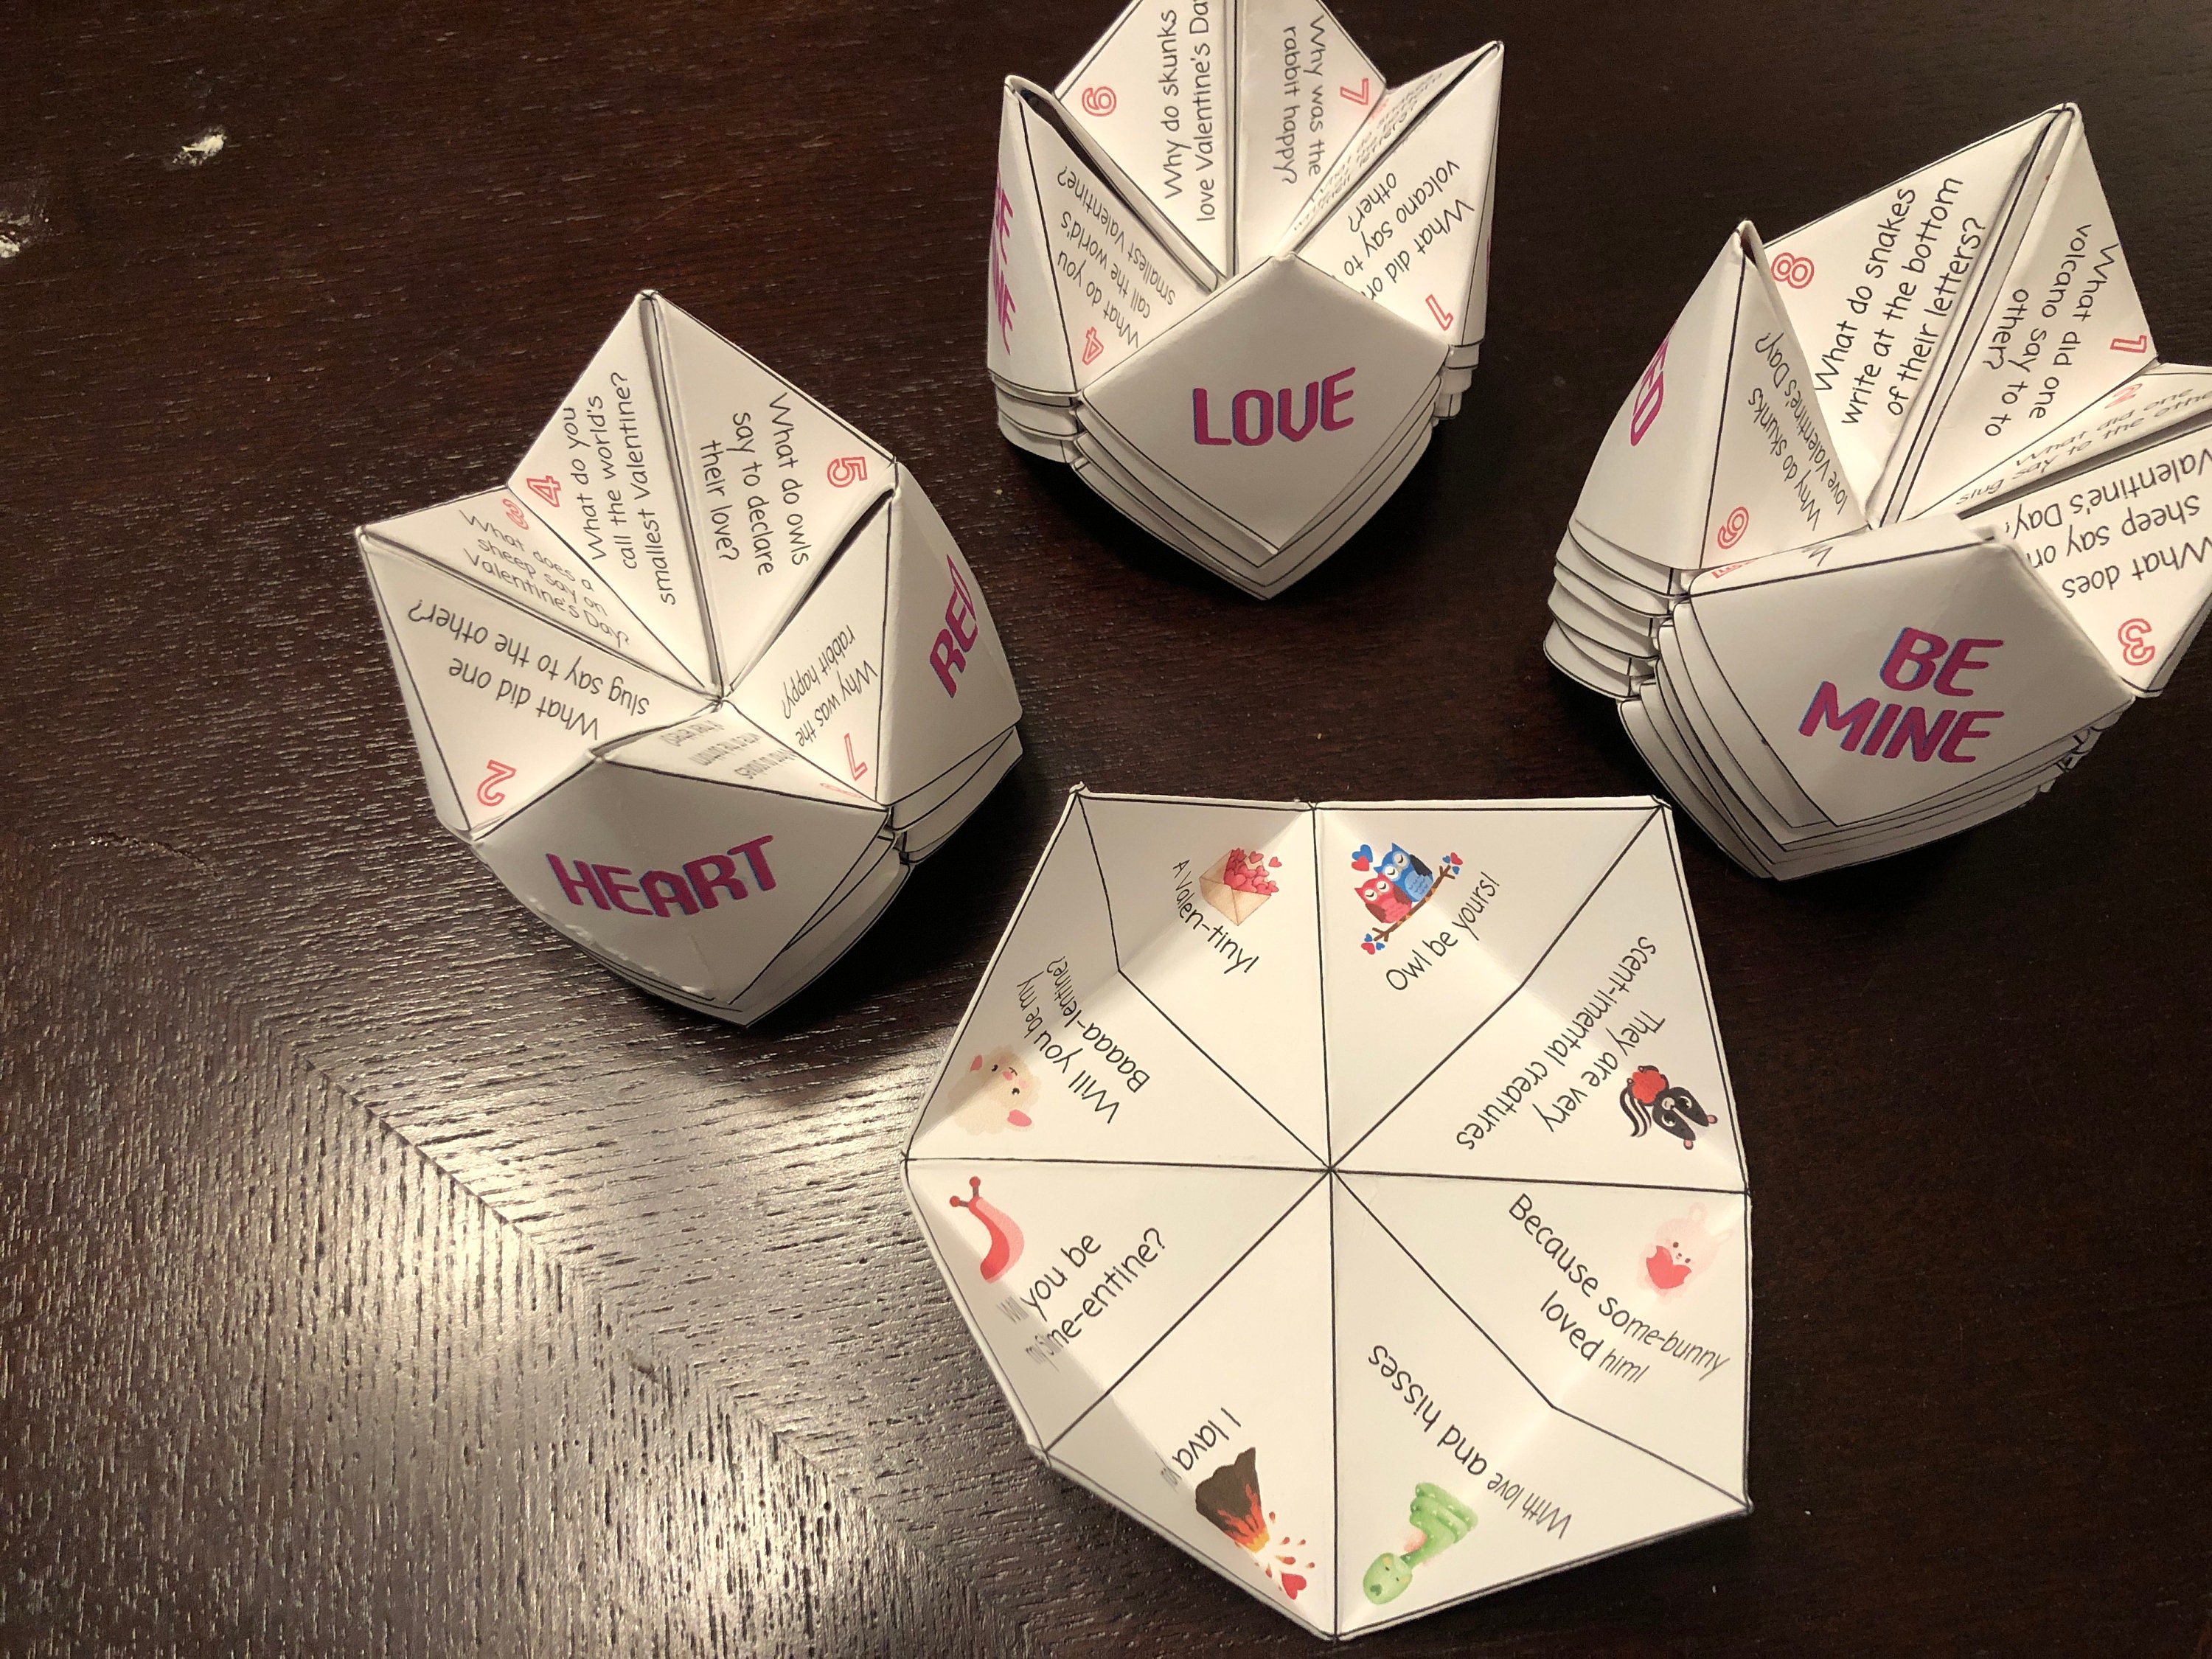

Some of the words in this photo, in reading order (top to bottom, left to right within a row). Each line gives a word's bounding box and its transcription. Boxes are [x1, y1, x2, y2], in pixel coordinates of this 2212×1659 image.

[1190, 0, 1208, 33] Da
[1158, 9, 1178, 97] skunks
[1283, 26, 1299, 97] rabbit
[1304, 15, 1325, 75] Why
[1082, 86, 1116, 116] 6
[1190, 42, 1214, 171] Valentine's
[1310, 86, 1324, 133] was
[1340, 78, 1368, 105] 7
[1161, 110, 1180, 132] do
[1273, 106, 1299, 184] happy?
[1309, 141, 1326, 176] the
[1164, 140, 1192, 199] Why
[1397, 160, 1460, 223] volcano
[1057, 167, 1125, 249] Valentine?
[1197, 179, 1214, 221] love
[1348, 173, 1397, 232] other?
[1061, 212, 1107, 265] world's
[1365, 221, 1393, 257] say
[1417, 199, 1475, 254] What
[1902, 178, 1963, 273] bottom
[1057, 251, 1086, 285] you
[1110, 262, 1127, 296] the
[1127, 244, 1175, 305] smallest
[1343, 254, 1363, 276] to
[1388, 251, 1411, 276] did
[1771, 252, 1814, 288] 8
[2042, 224, 2091, 318] volcano
[2073, 243, 2118, 321] What
[1086, 282, 1102, 305] do
[1130, 290, 1151, 318] call
[1363, 277, 1382, 300] on
[1815, 320, 1858, 391] What
[1848, 286, 1872, 314] do
[1866, 188, 1916, 279] snakes
[1882, 282, 1916, 322] the
[1104, 308, 1138, 348] What
[1425, 294, 1453, 330] 1
[1888, 386, 1908, 415] of
[1898, 323, 1938, 380] their
[1924, 218, 1986, 316] letters?
[1983, 289, 2028, 369] other?
[1082, 327, 1104, 365] 4
[1755, 332, 1790, 388] Day?
[1874, 329, 1895, 357] at
[2008, 329, 2047, 372] say
[2053, 331, 2081, 366] did
[2110, 335, 2146, 353] 1
[1193, 367, 1355, 446] LOVE
[1842, 364, 1880, 423] write
[2001, 381, 2028, 404] to
[2029, 377, 2059, 419] one
[2154, 392, 2212, 418] othe
[564, 408, 591, 450] you
[588, 396, 613, 479] world's
[611, 373, 650, 499] Valentine?
[727, 411, 755, 456] say
[770, 393, 799, 469] What
[1748, 389, 1787, 456] skunks
[1784, 380, 1832, 481] Valentine's
[1985, 414, 2011, 436] to
[572, 459, 589, 484] do
[742, 462, 761, 487] to
[782, 476, 802, 504] do
[827, 456, 867, 487] 5
[1784, 455, 1797, 481] do
[527, 476, 561, 507] 4
[608, 490, 622, 526] the
[700, 440, 723, 496] their
[712, 506, 740, 561] love?
[1794, 469, 1820, 531] Why
[1827, 470, 1848, 515] love
[502, 499, 529, 530] 3
[581, 488, 607, 560] What
[748, 495, 774, 576] declare
[1717, 507, 1749, 549] 6
[2121, 495, 2199, 536] sheep
[459, 510, 525, 552] What
[533, 551, 574, 582] does
[582, 579, 594, 592] a
[622, 536, 637, 569] call
[642, 509, 675, 605] smallest
[787, 514, 811, 566] owls
[2027, 545, 2056, 568] on
[2066, 525, 2110, 556] say
[2132, 537, 2212, 581] What
[464, 549, 580, 618] Valentine's
[584, 611, 630, 644] Day?
[479, 539, 536, 577] sheep
[546, 573, 577, 601] say
[584, 596, 608, 616] on
[2062, 565, 2119, 598] does
[408, 599, 488, 644] other?
[931, 554, 978, 698] RED
[2118, 619, 2154, 666] 3
[495, 633, 530, 667] the
[538, 655, 558, 676] to
[821, 625, 855, 674] rabbit
[1879, 626, 2004, 697] BE
[449, 658, 490, 688] one
[496, 679, 530, 709] did
[566, 655, 603, 694] say
[841, 661, 877, 702] Why
[537, 696, 598, 740] What
[610, 676, 650, 716] slug
[815, 693, 841, 727] was
[799, 720, 817, 746] the
[1798, 681, 2004, 762] MINE
[844, 733, 867, 781] 7
[477, 760, 516, 807] 2
[546, 835, 776, 917] HEART
[1173, 860, 1190, 879] A
[1175, 872, 1259, 974] Valen-tiny!
[1386, 949, 1432, 990] Owl
[1422, 931, 1458, 958] be
[1452, 871, 1501, 941] yours!
[1017, 971, 1044, 1010] my
[1544, 936, 1656, 1067] scent-imental
[1023, 1006, 1043, 1038] be
[1607, 1010, 1666, 1056] They
[1034, 1031, 1083, 1073] you
[1582, 1051, 1618, 1089] are
[1068, 1071, 1119, 1124] Will
[1457, 1060, 1548, 1150] creatures
[1533, 1087, 1587, 1132] very
[1020, 1267, 1068, 1321] you
[1061, 1234, 1101, 1267] be
[1509, 1194, 1599, 1297] Because
[1599, 1297, 1730, 1380] some-bunny
[1540, 1291, 1604, 1361] loved
[1599, 1349, 1649, 1383] him!
[1369, 1345, 1442, 1432] hisses
[1221, 1408, 1241, 1427] I
[1172, 1420, 1229, 1470] lava
[1438, 1425, 1488, 1475] and
[1487, 1472, 1522, 1509] love
[1523, 1492, 1572, 1540] With
